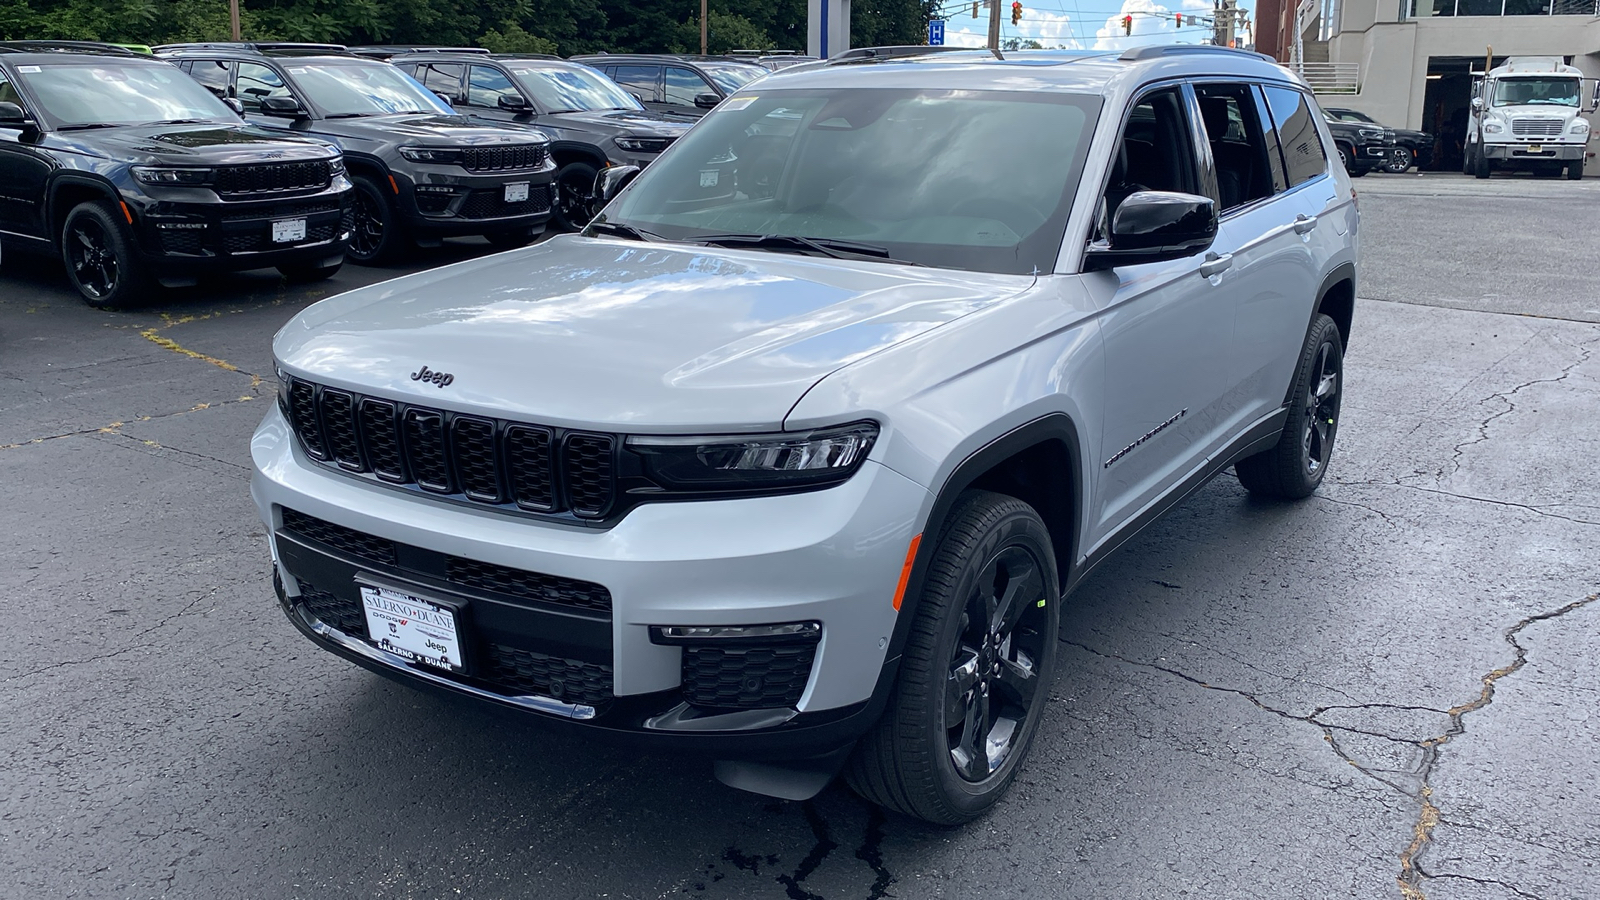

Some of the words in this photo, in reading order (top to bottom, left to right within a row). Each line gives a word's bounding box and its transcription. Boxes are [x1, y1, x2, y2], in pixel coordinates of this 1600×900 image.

[932, 26, 941, 38] H
[410, 365, 455, 389] Jeep
[365, 595, 412, 617] SALERNO
[417, 609, 454, 630] DUANE
[377, 641, 414, 659] SALERNO
[424, 656, 453, 671] DUANE
[424, 638, 448, 655] Jeep
